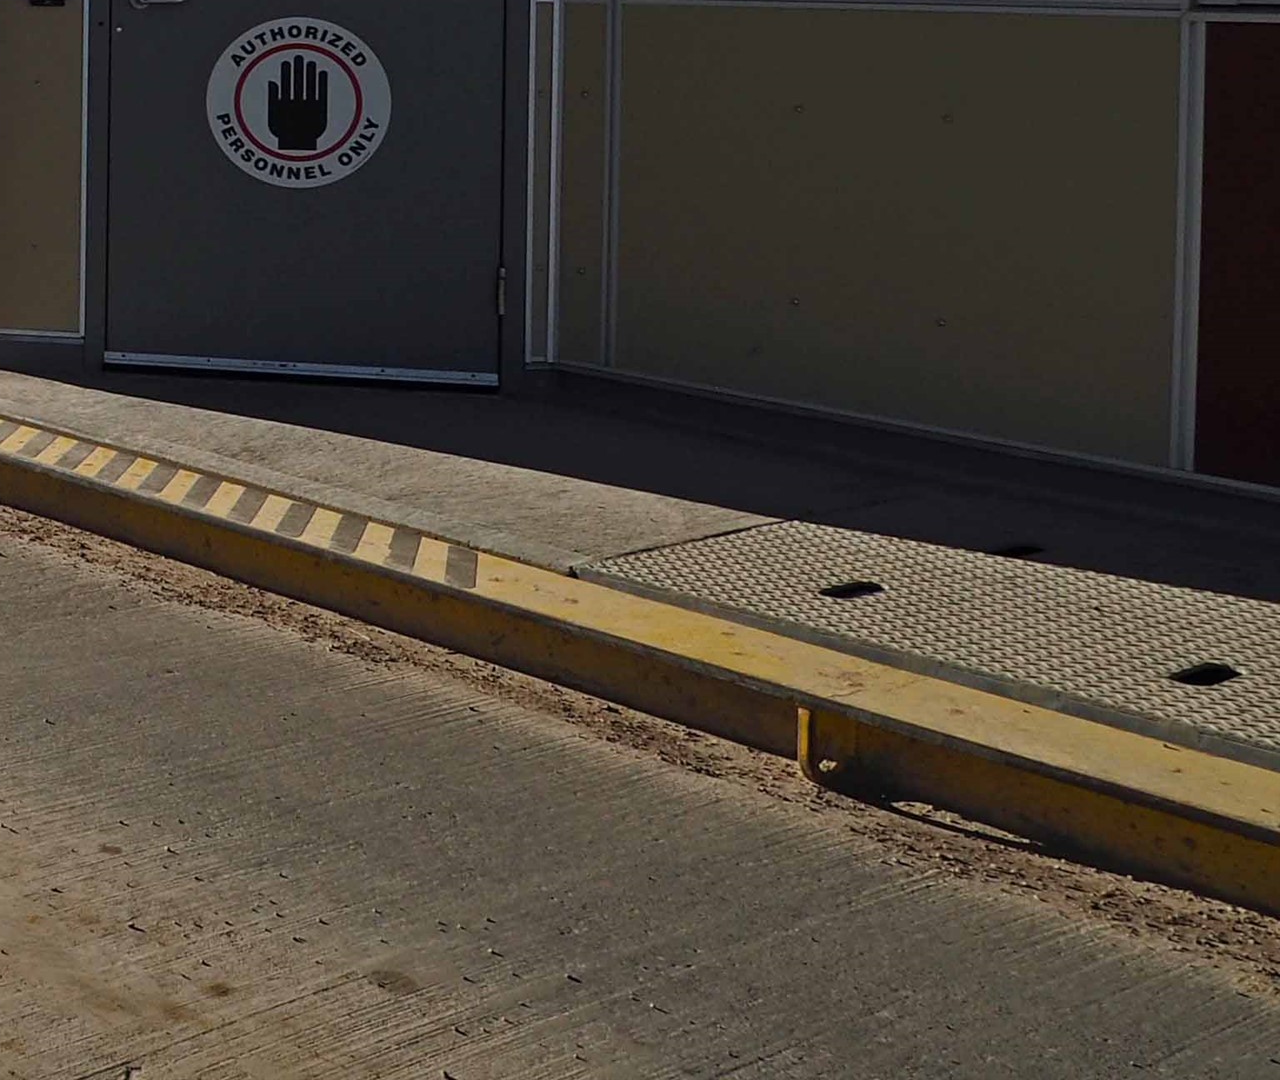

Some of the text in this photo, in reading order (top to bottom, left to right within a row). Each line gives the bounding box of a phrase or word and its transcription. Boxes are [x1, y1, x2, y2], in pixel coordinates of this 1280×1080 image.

[230, 24, 368, 68] AUTHORIZED
[216, 112, 380, 180] PERSONNEL ONLY
